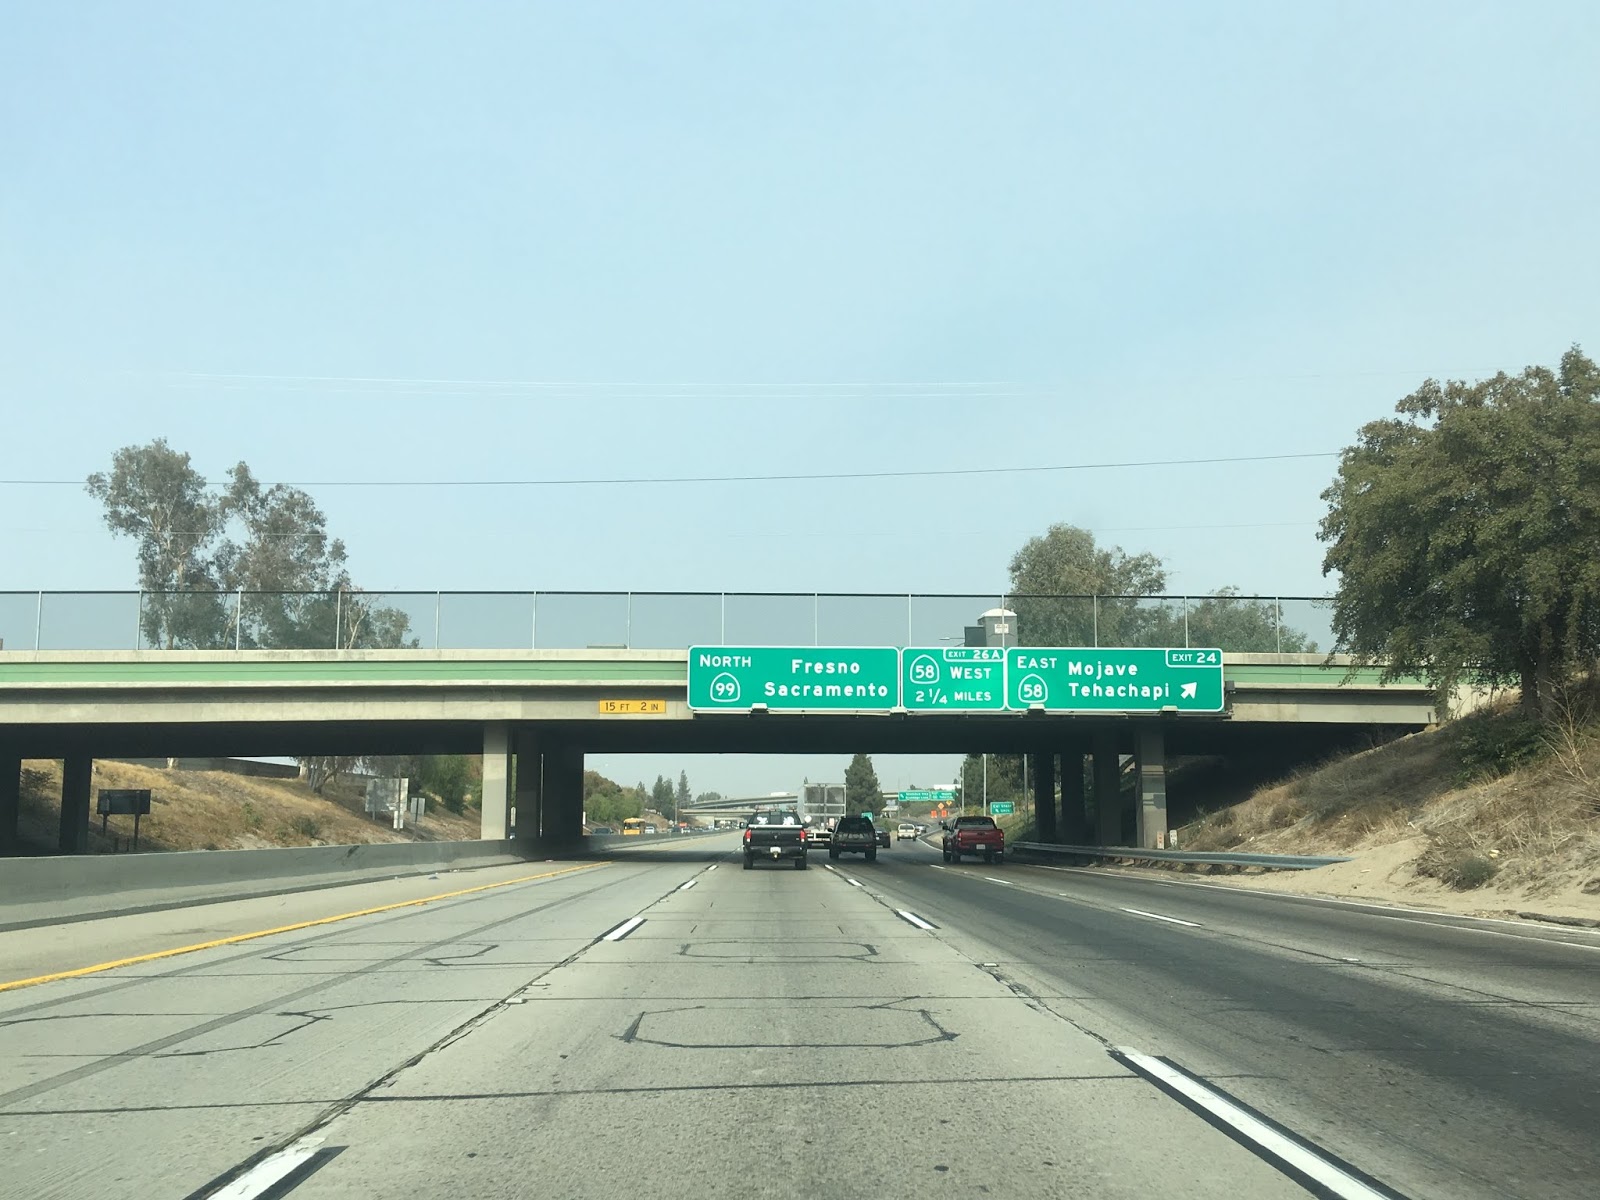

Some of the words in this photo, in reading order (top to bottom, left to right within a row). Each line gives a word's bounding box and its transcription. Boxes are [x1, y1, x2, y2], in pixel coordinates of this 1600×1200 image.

[700, 655, 751, 667] NORTH
[948, 651, 967, 659] EXIT
[973, 649, 1000, 660] 26A
[1172, 653, 1193, 662] EXIT
[1196, 652, 1217, 664] 24
[791, 659, 860, 674] Fresno
[1017, 656, 1057, 669] EAST
[915, 664, 935, 679] 58
[950, 667, 992, 680] WEST
[1068, 661, 1138, 680] Mojave
[715, 682, 735, 697] 99
[764, 682, 888, 697] Sacramento
[954, 691, 992, 701] MILES
[1022, 683, 1043, 698] 58
[1068, 683, 1169, 701] Tehachapi
[605, 702, 616, 711] 15
[640, 701, 647, 711] 2
[650, 703, 659, 711] IN
